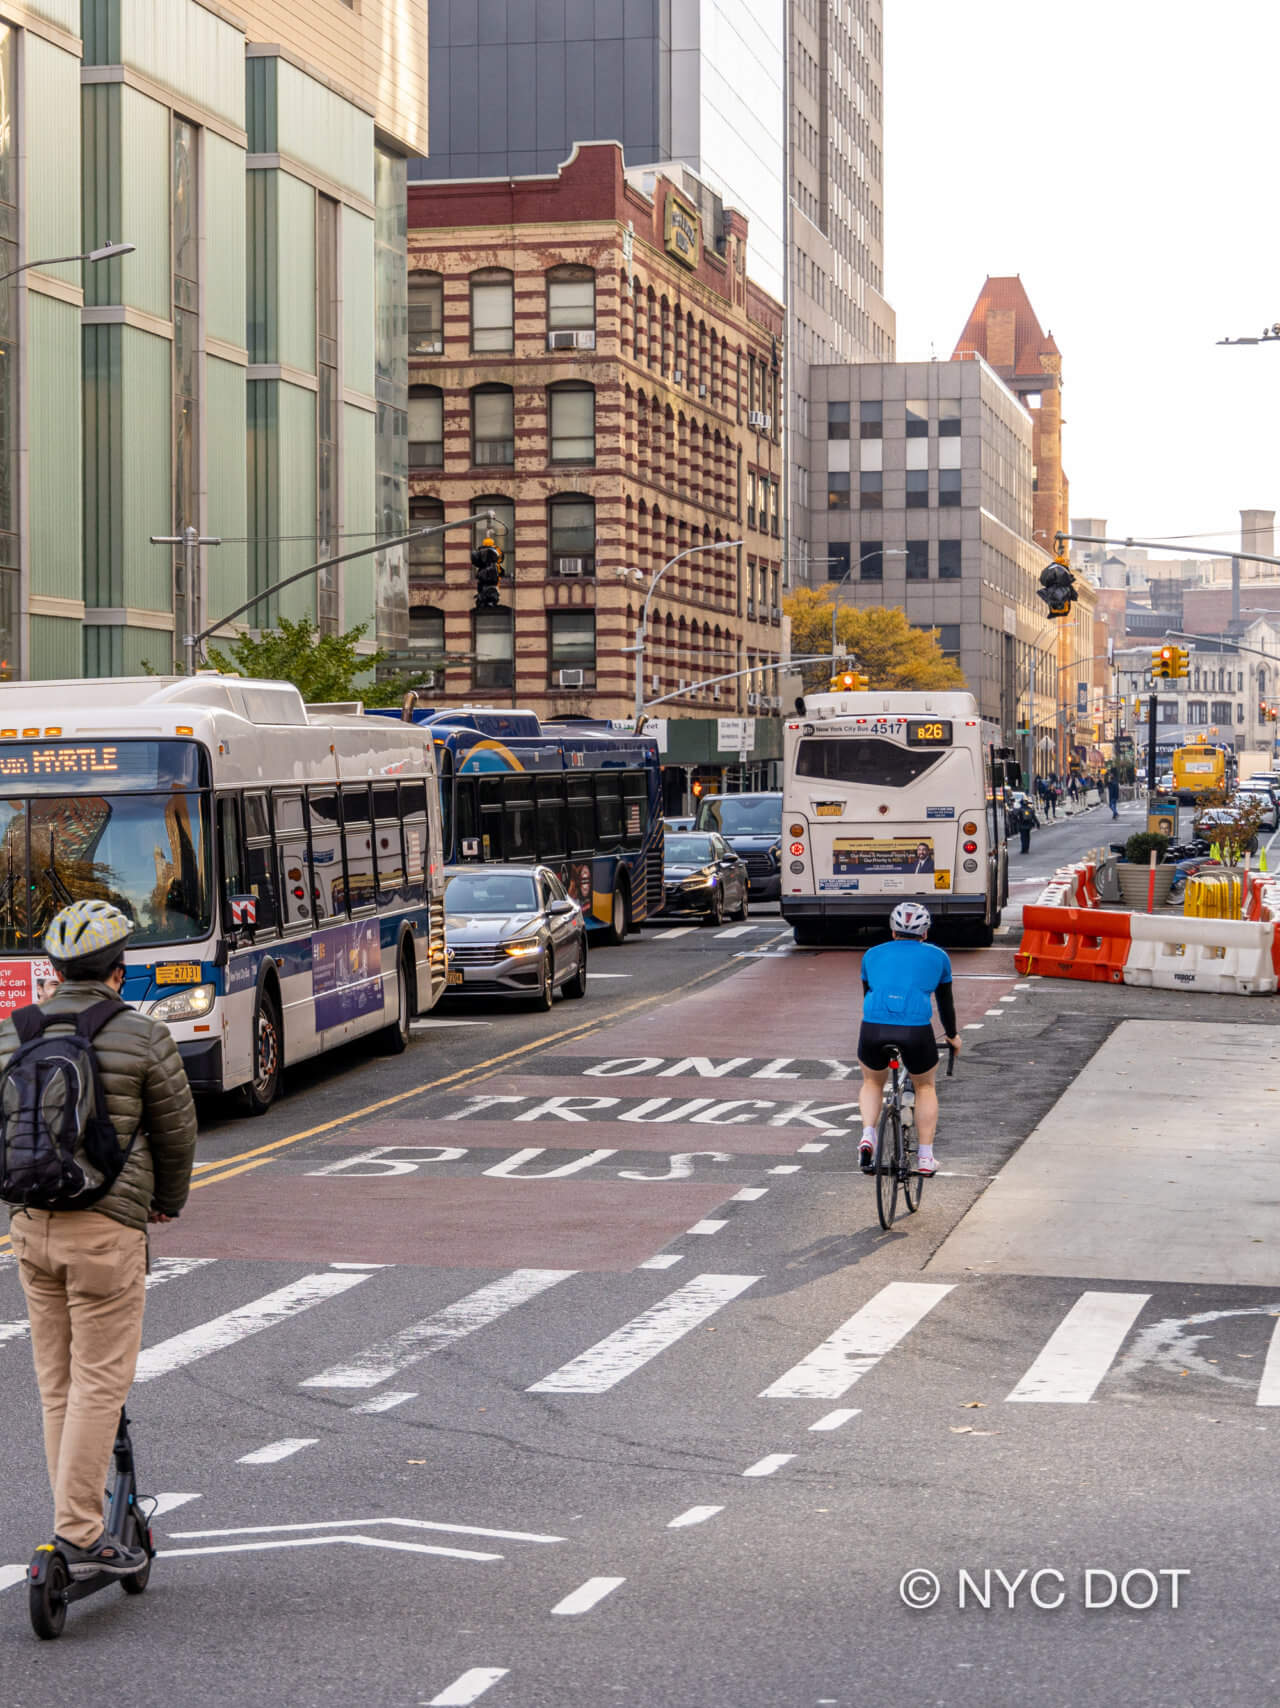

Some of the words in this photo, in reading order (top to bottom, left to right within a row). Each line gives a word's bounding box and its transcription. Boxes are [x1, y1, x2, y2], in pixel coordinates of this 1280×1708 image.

[871, 723, 902, 734] 4517
[917, 723, 943, 739] B26
[32, 747, 118, 773] MYRTLE
[9, 979, 26, 987] can
[7, 990, 26, 1000] you
[582, 1057, 861, 1080] ONLY
[438, 1094, 860, 1130] TRUCK
[303, 1146, 733, 1181] BUS
